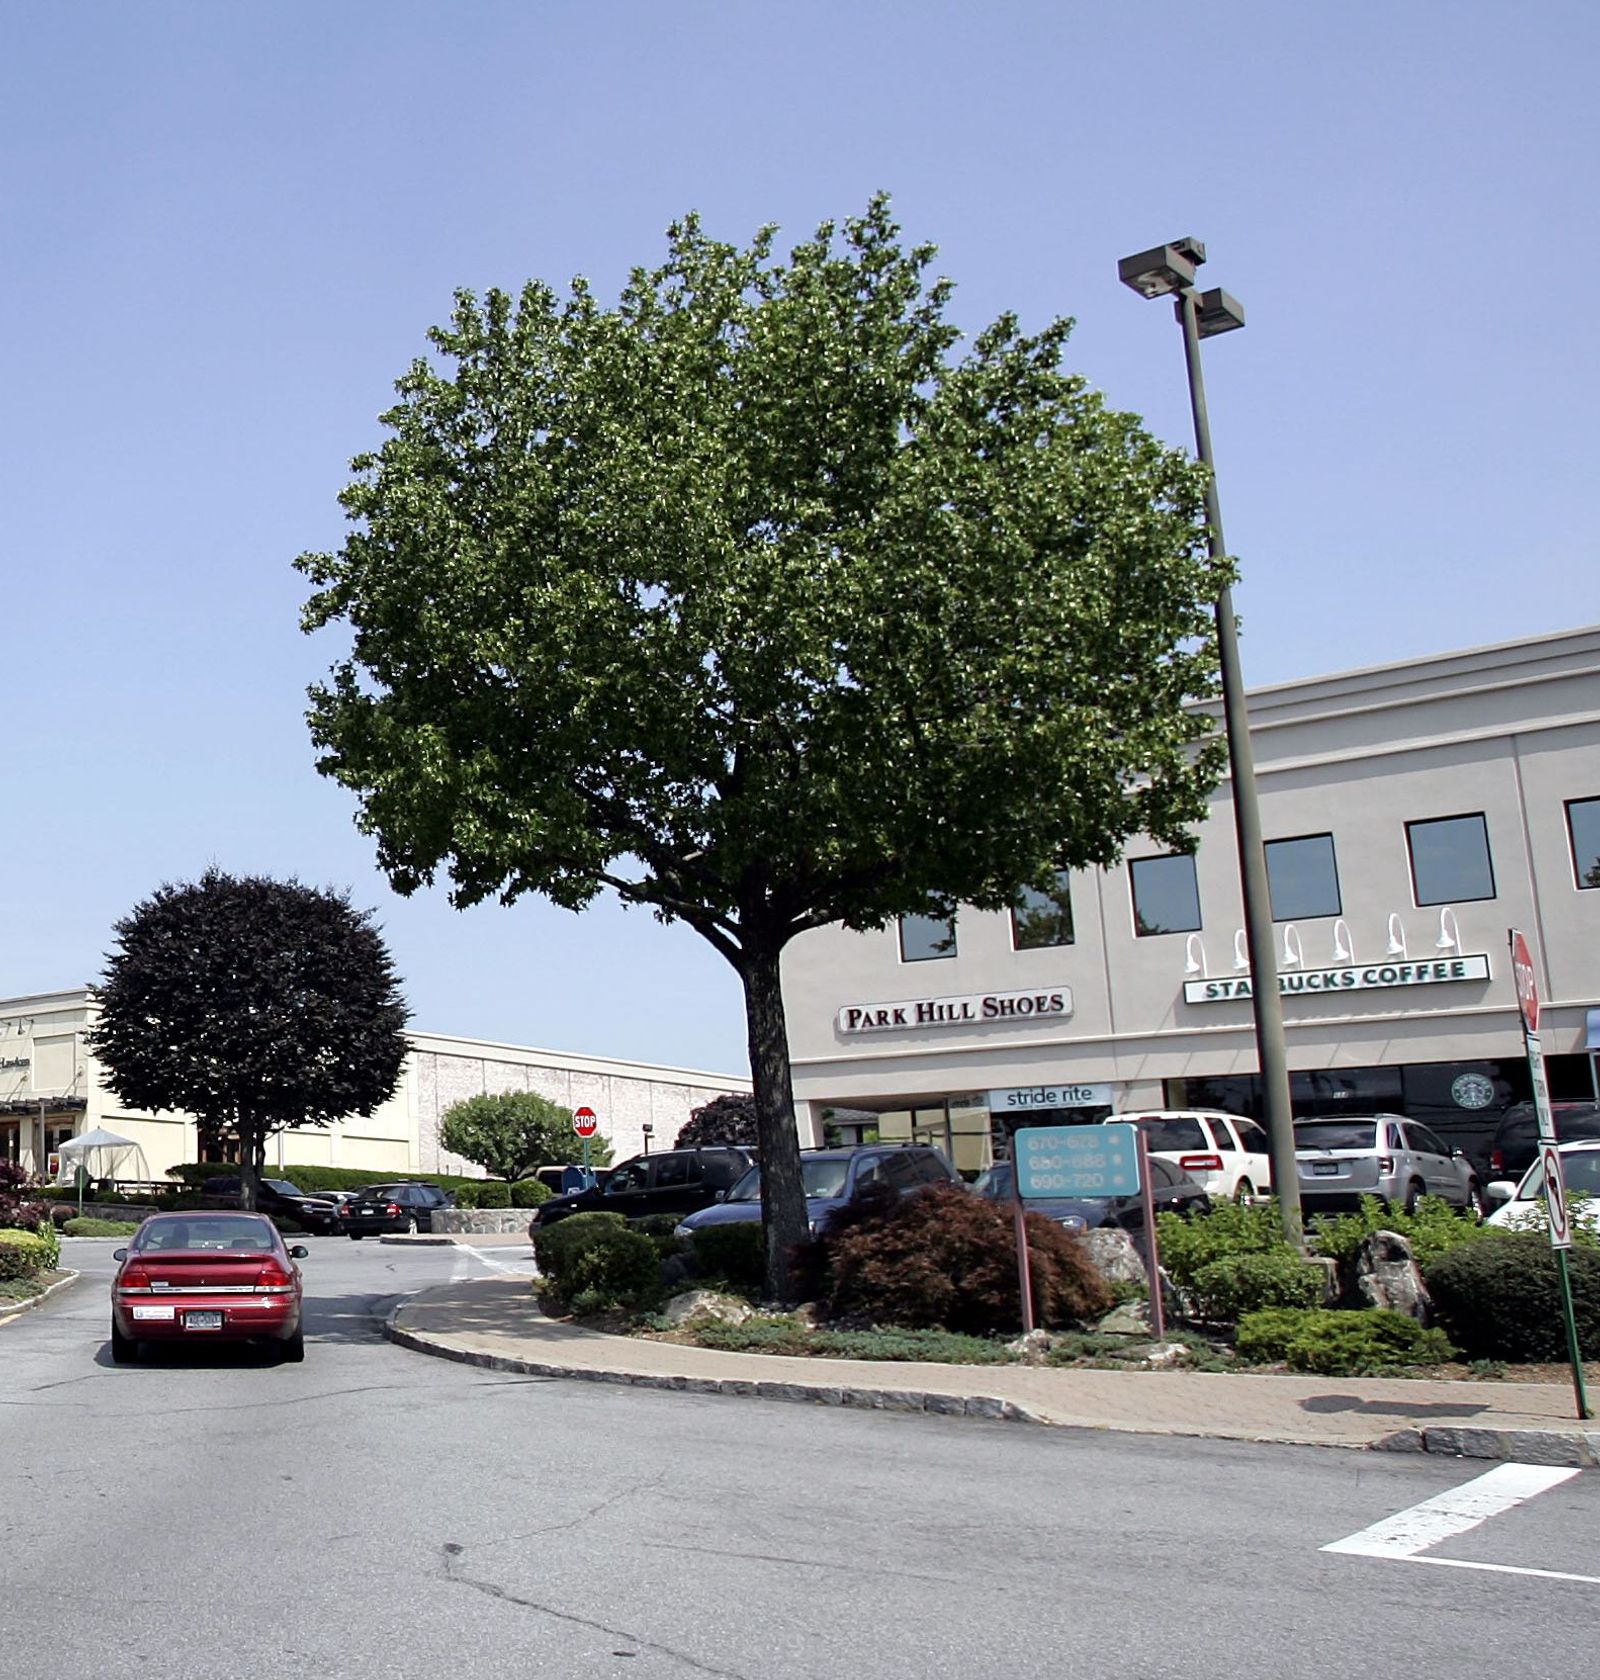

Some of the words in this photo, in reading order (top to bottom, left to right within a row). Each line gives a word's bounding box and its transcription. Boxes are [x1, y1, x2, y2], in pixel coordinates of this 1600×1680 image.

[1205, 971, 1355, 998] STABUCKS
[1362, 961, 1466, 985] COFFEE
[1007, 1089, 1057, 1107] stride
[1062, 1085, 1093, 1102] rite
[575, 1115, 595, 1128] STOP
